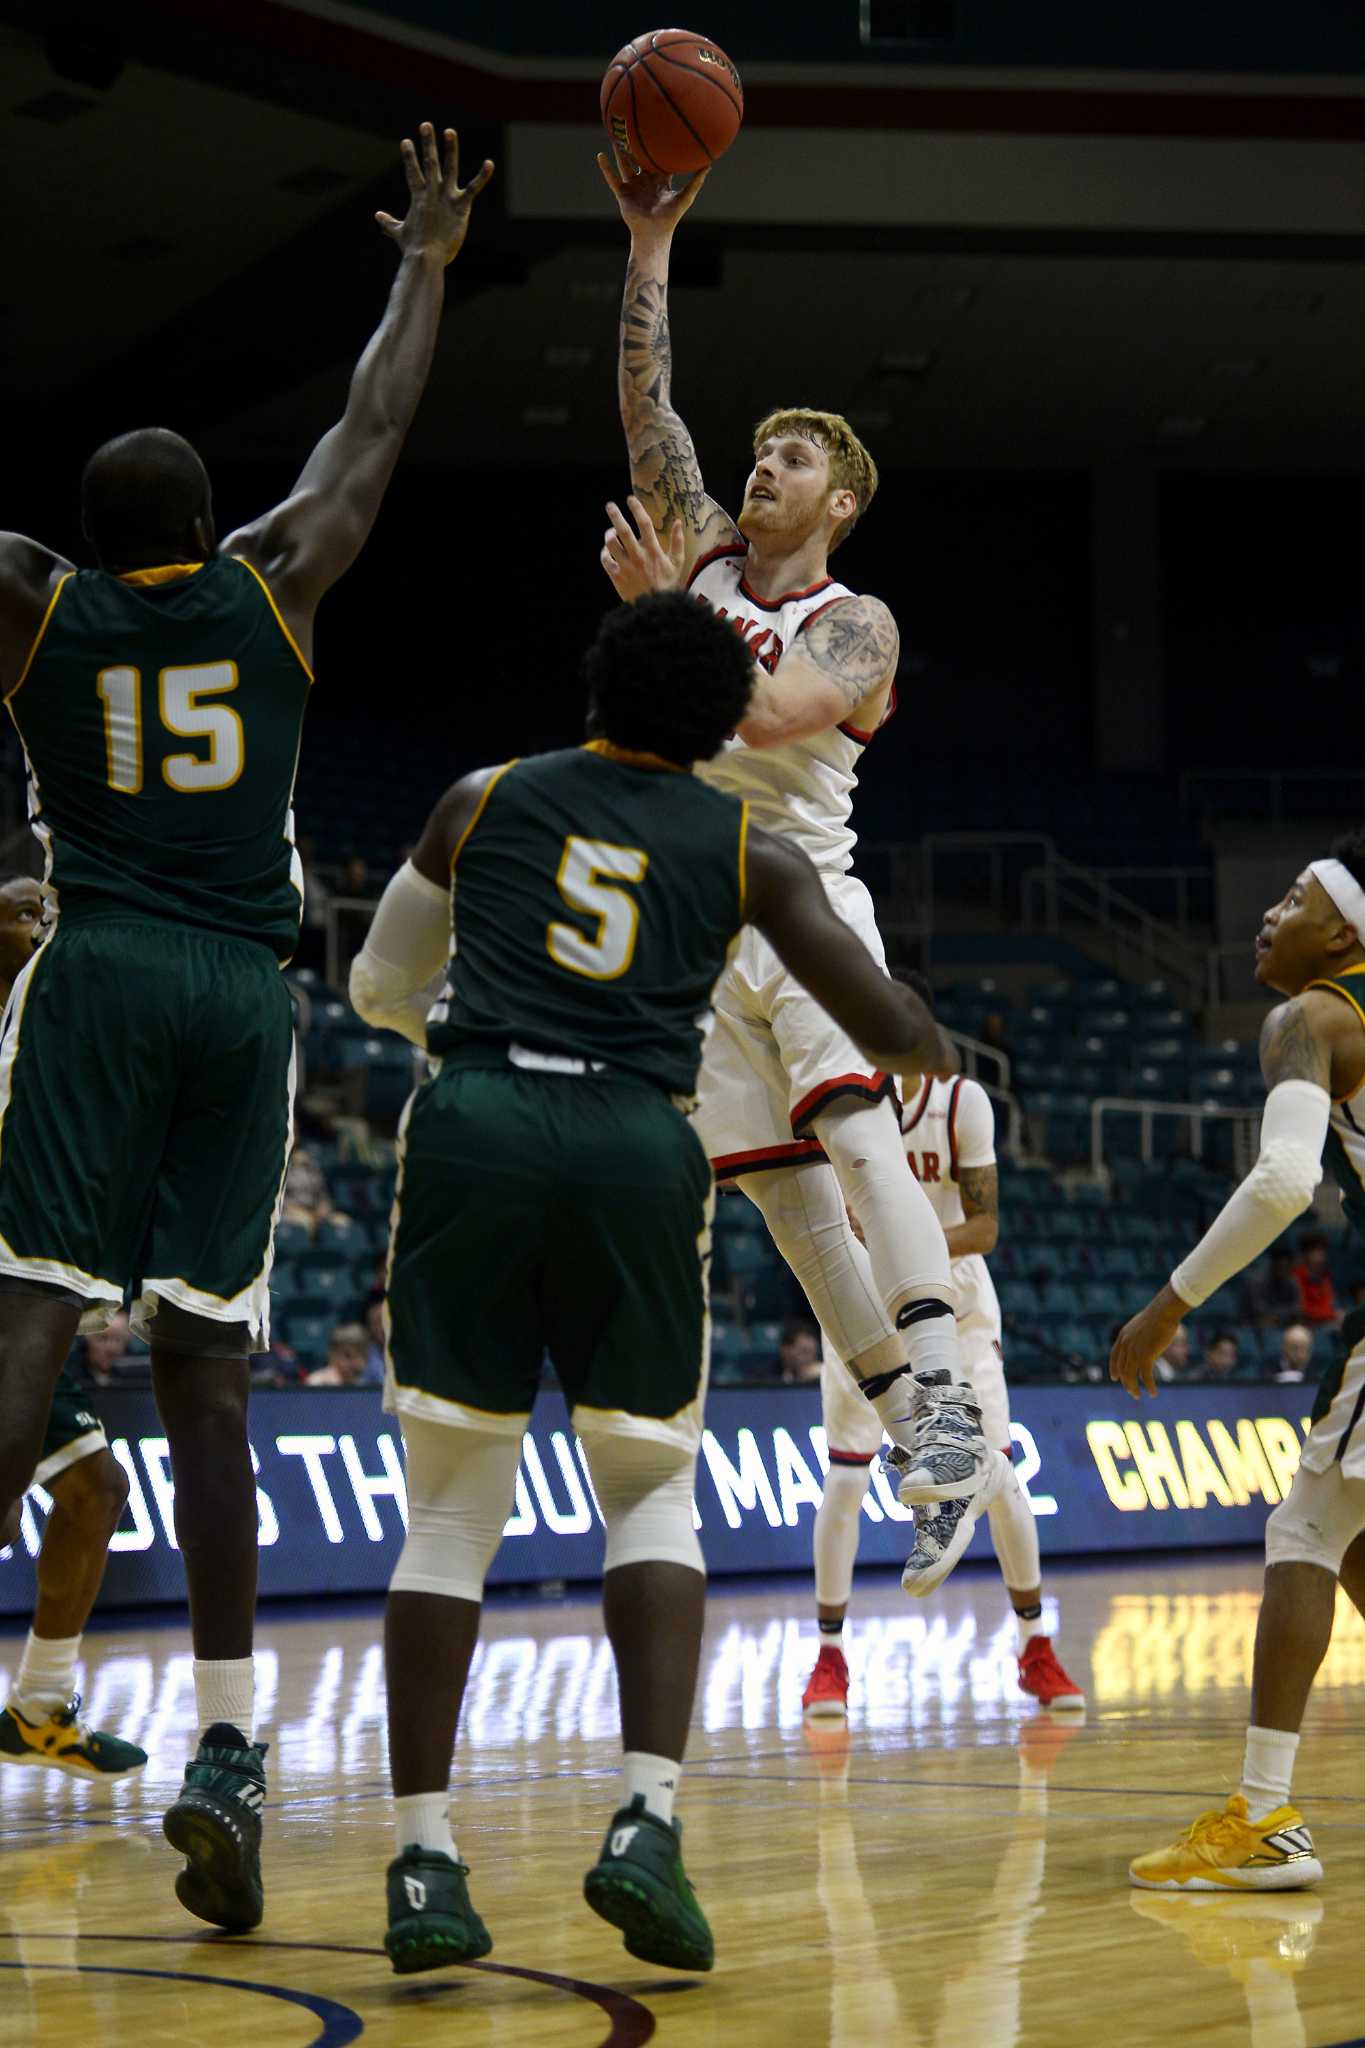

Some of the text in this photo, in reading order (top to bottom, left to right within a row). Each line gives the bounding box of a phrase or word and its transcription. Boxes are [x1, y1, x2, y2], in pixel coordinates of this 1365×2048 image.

[96, 659, 245, 794] 15
[545, 833, 649, 982] 5
[1086, 1416, 1312, 1511] CHAMP
